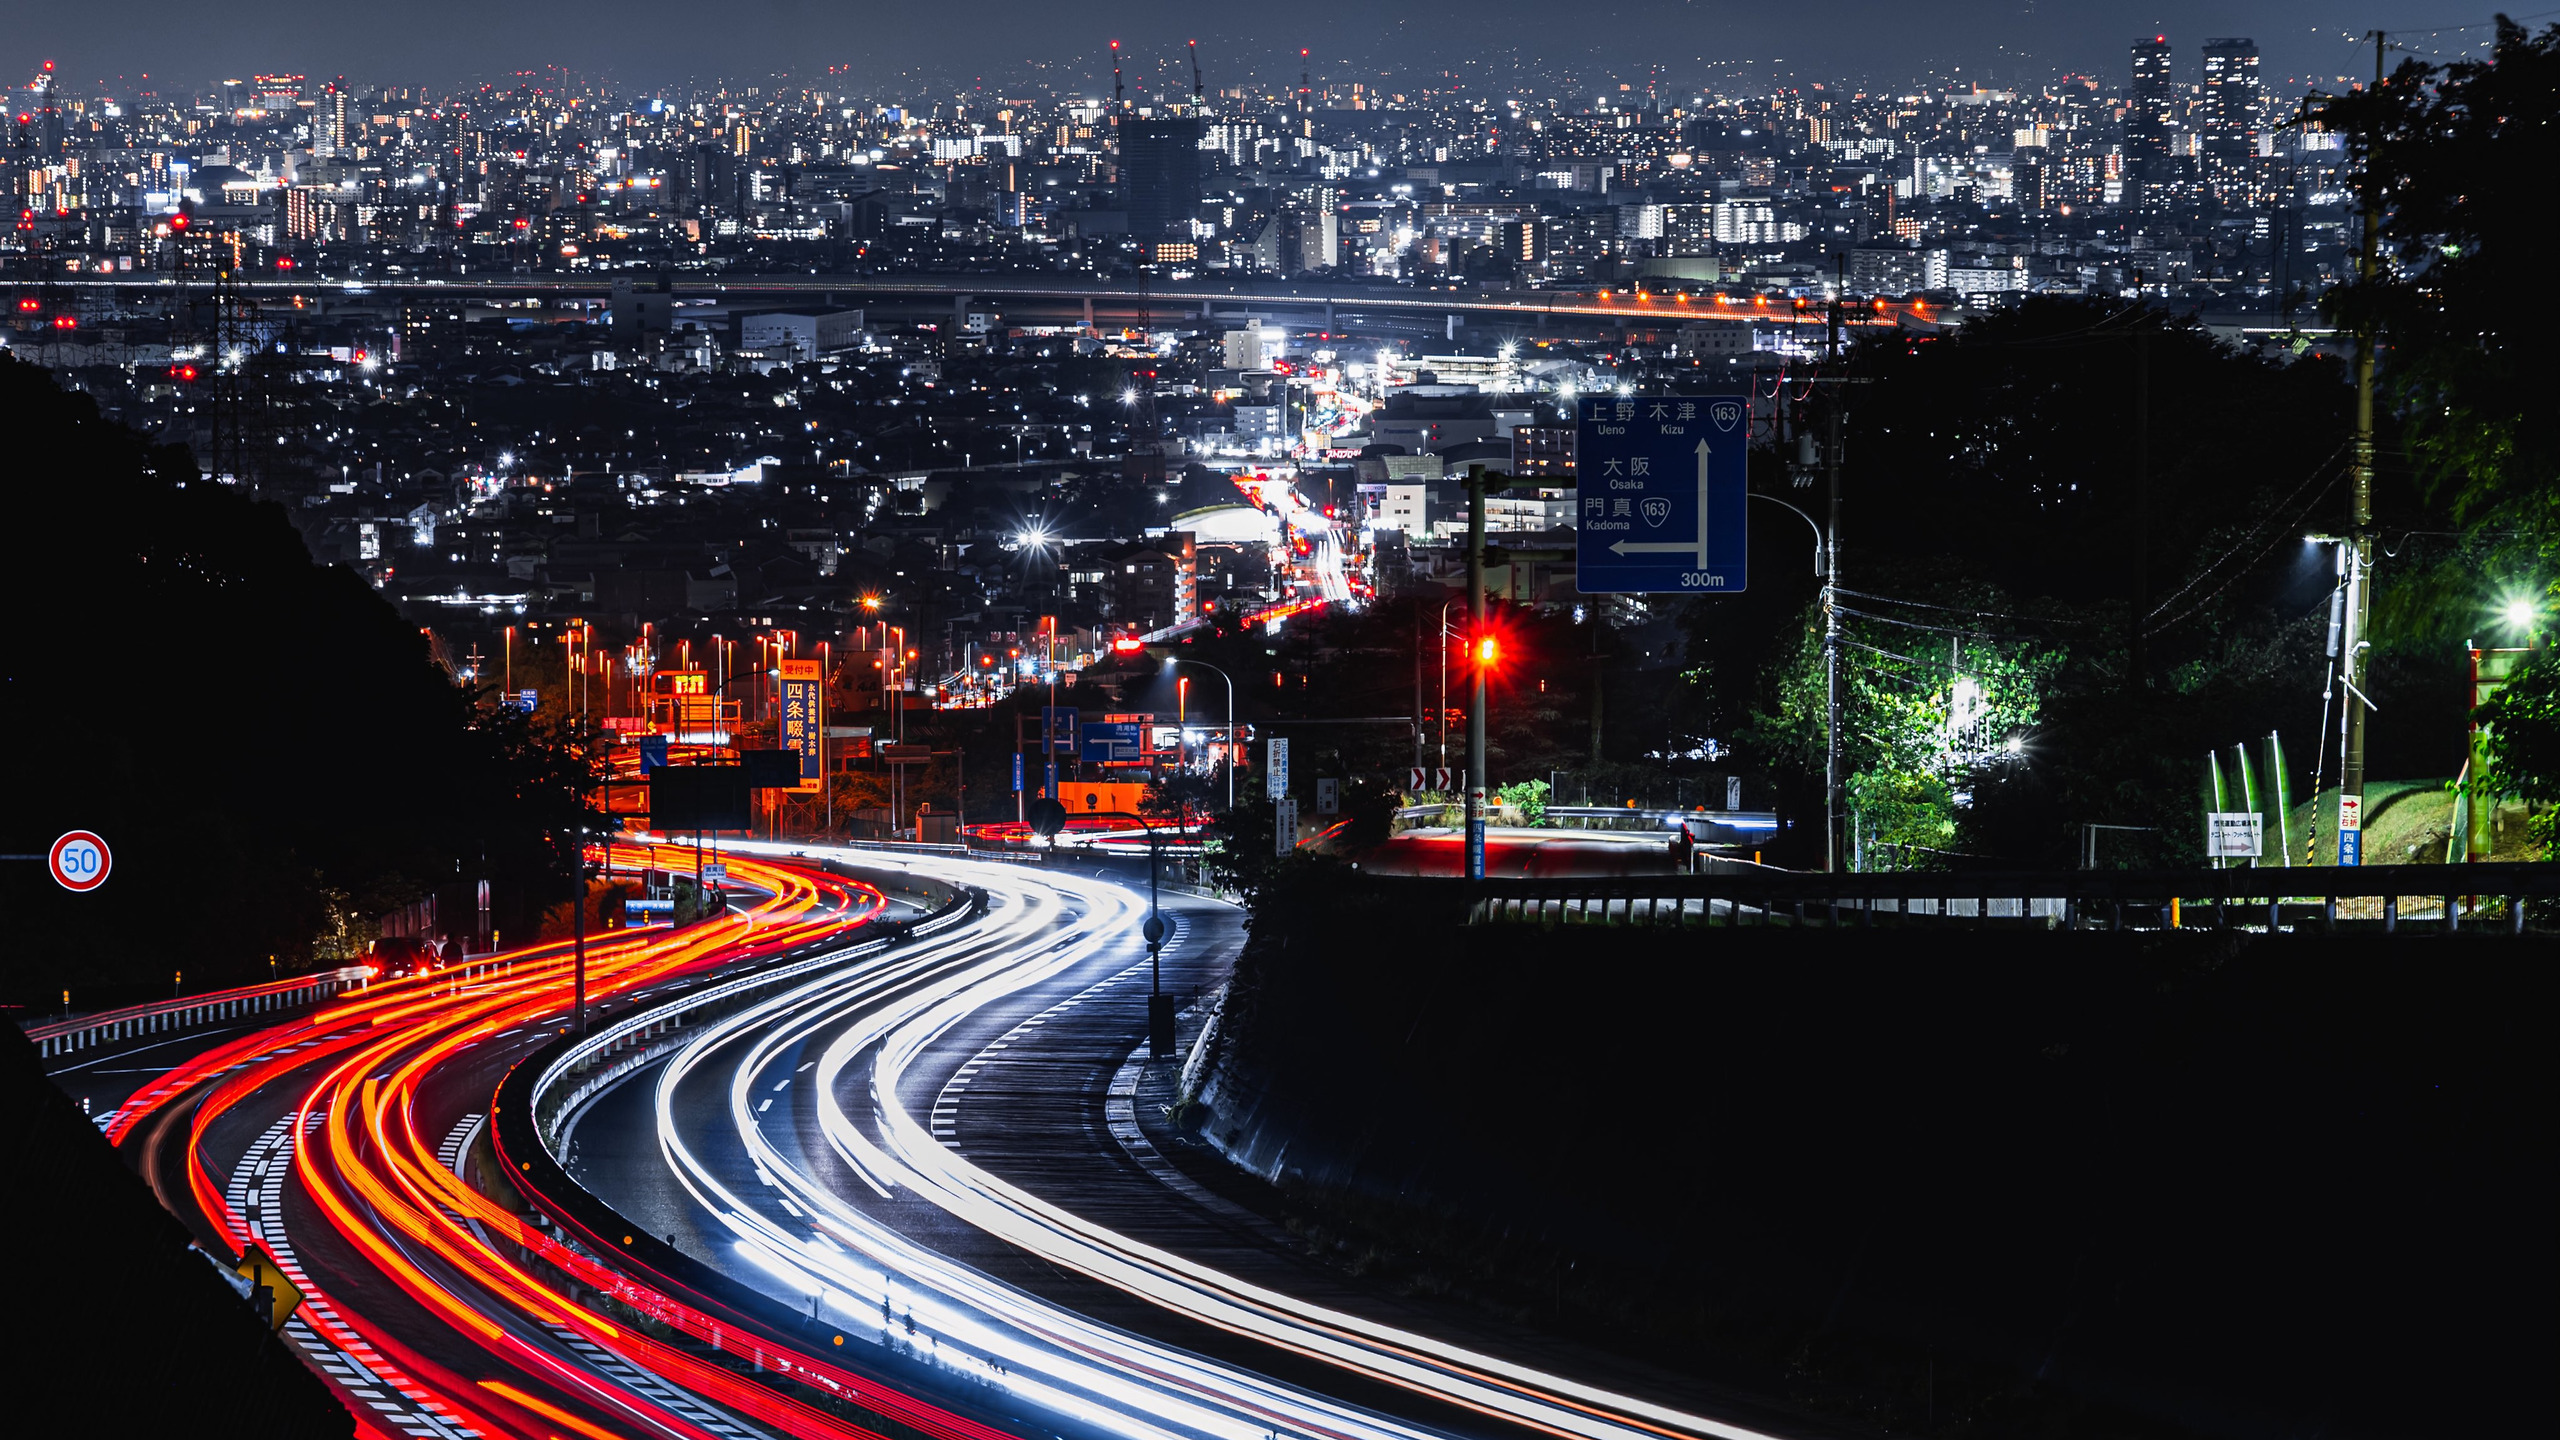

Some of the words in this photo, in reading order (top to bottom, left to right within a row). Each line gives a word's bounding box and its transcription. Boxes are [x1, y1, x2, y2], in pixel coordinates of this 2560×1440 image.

[1588, 402, 1635, 422] 上野
[1649, 402, 1696, 422] 木津
[1715, 406, 1736, 421] 163
[1598, 424, 1625, 435] Ueno
[1661, 424, 1684, 435] Kizu
[1603, 457, 1650, 476] 大阪
[1610, 479, 1644, 490] Osaka
[1585, 498, 1632, 517] 門真
[1644, 502, 1665, 517] 163
[1586, 519, 1630, 531] Kadoma
[1681, 572, 1724, 587] 300m
[784, 665, 814, 675] 受付中
[787, 683, 804, 775] 四条畷霊
[1273, 740, 1281, 777] 右折禁止
[64, 848, 97, 873] 50
